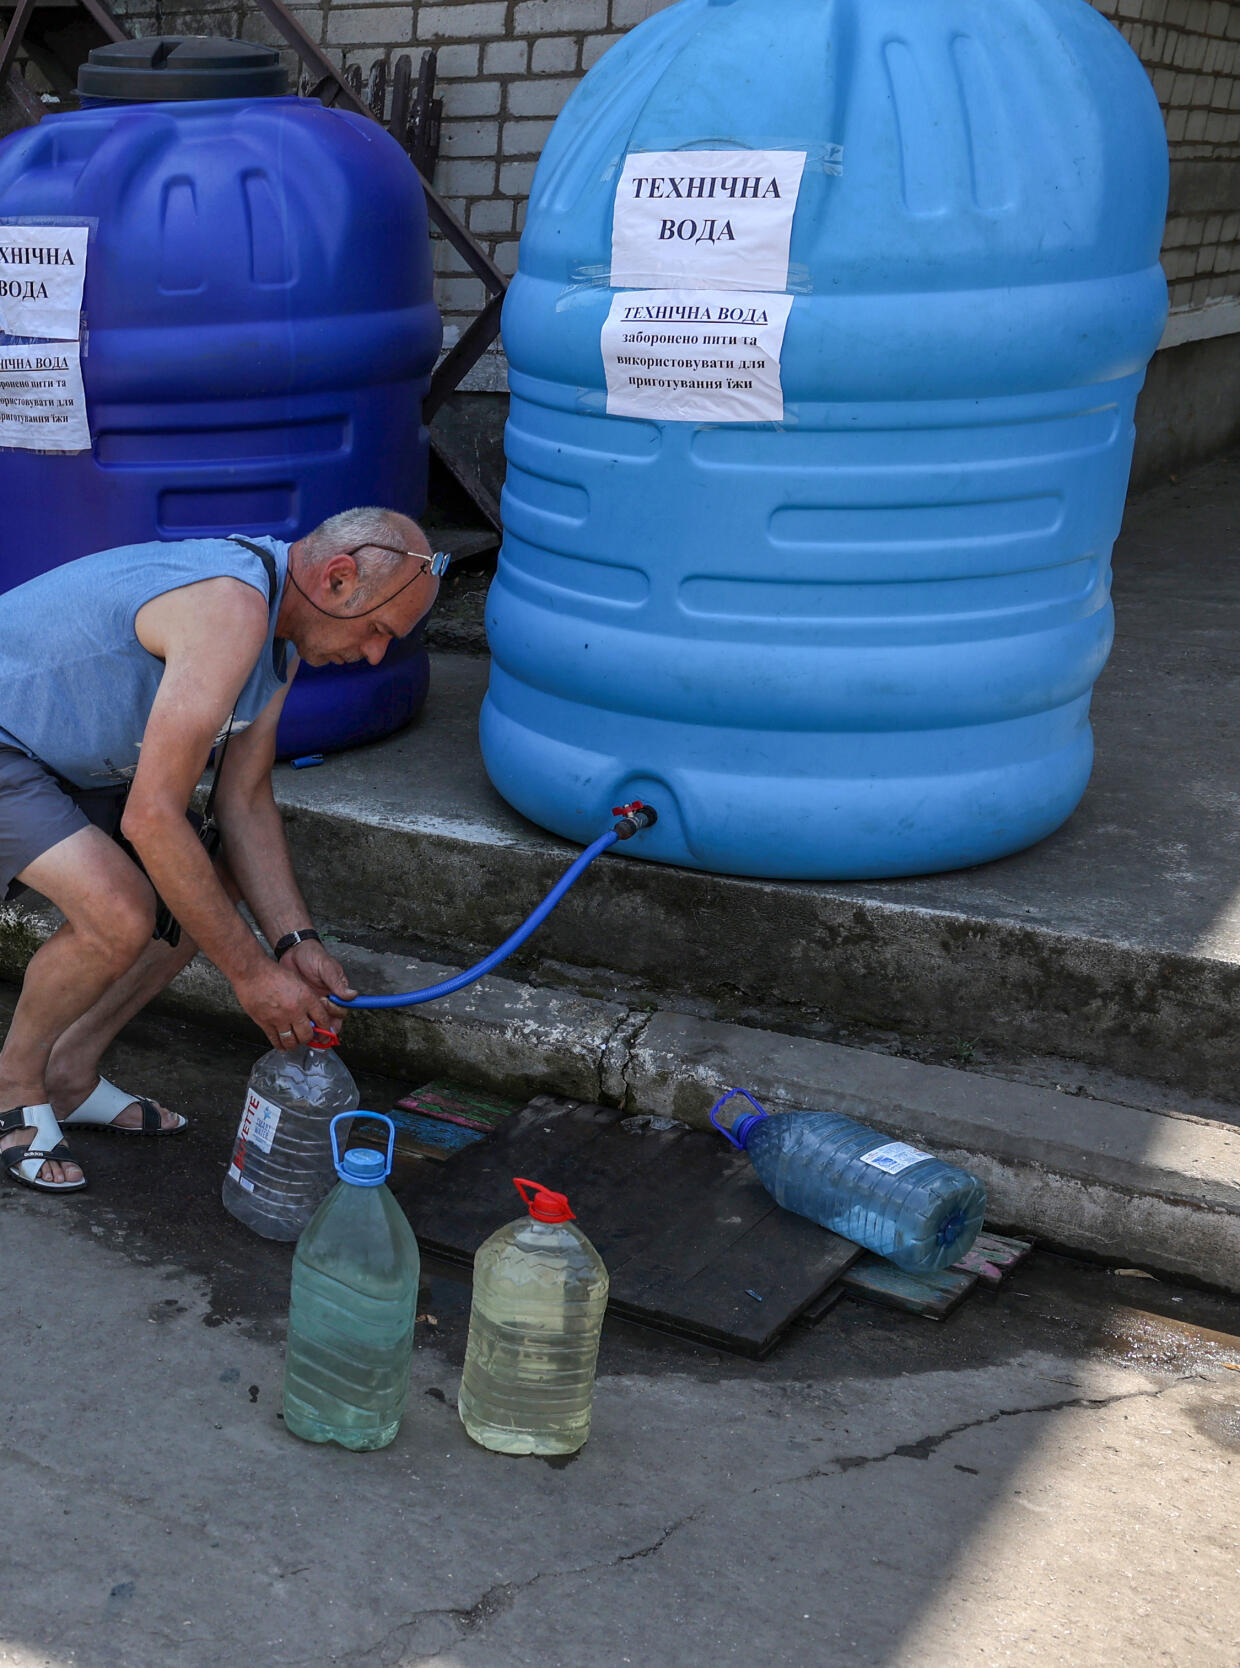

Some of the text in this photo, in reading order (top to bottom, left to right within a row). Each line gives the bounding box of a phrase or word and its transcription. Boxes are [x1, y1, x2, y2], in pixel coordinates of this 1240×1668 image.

[632, 176, 781, 199] ТЕХНІЧНА
[658, 219, 736, 245] ВОДА
[624, 305, 768, 324] ТЕХНІЧНА ВОДА
[622, 331, 758, 347] заборонено пити та
[35, 356, 69, 369] ВОДА
[616, 354, 765, 372] використовувати для
[30, 380, 54, 388] пити
[56, 379, 66, 388] та
[628, 375, 753, 391] приготування їжи
[56, 398, 74, 408] для
